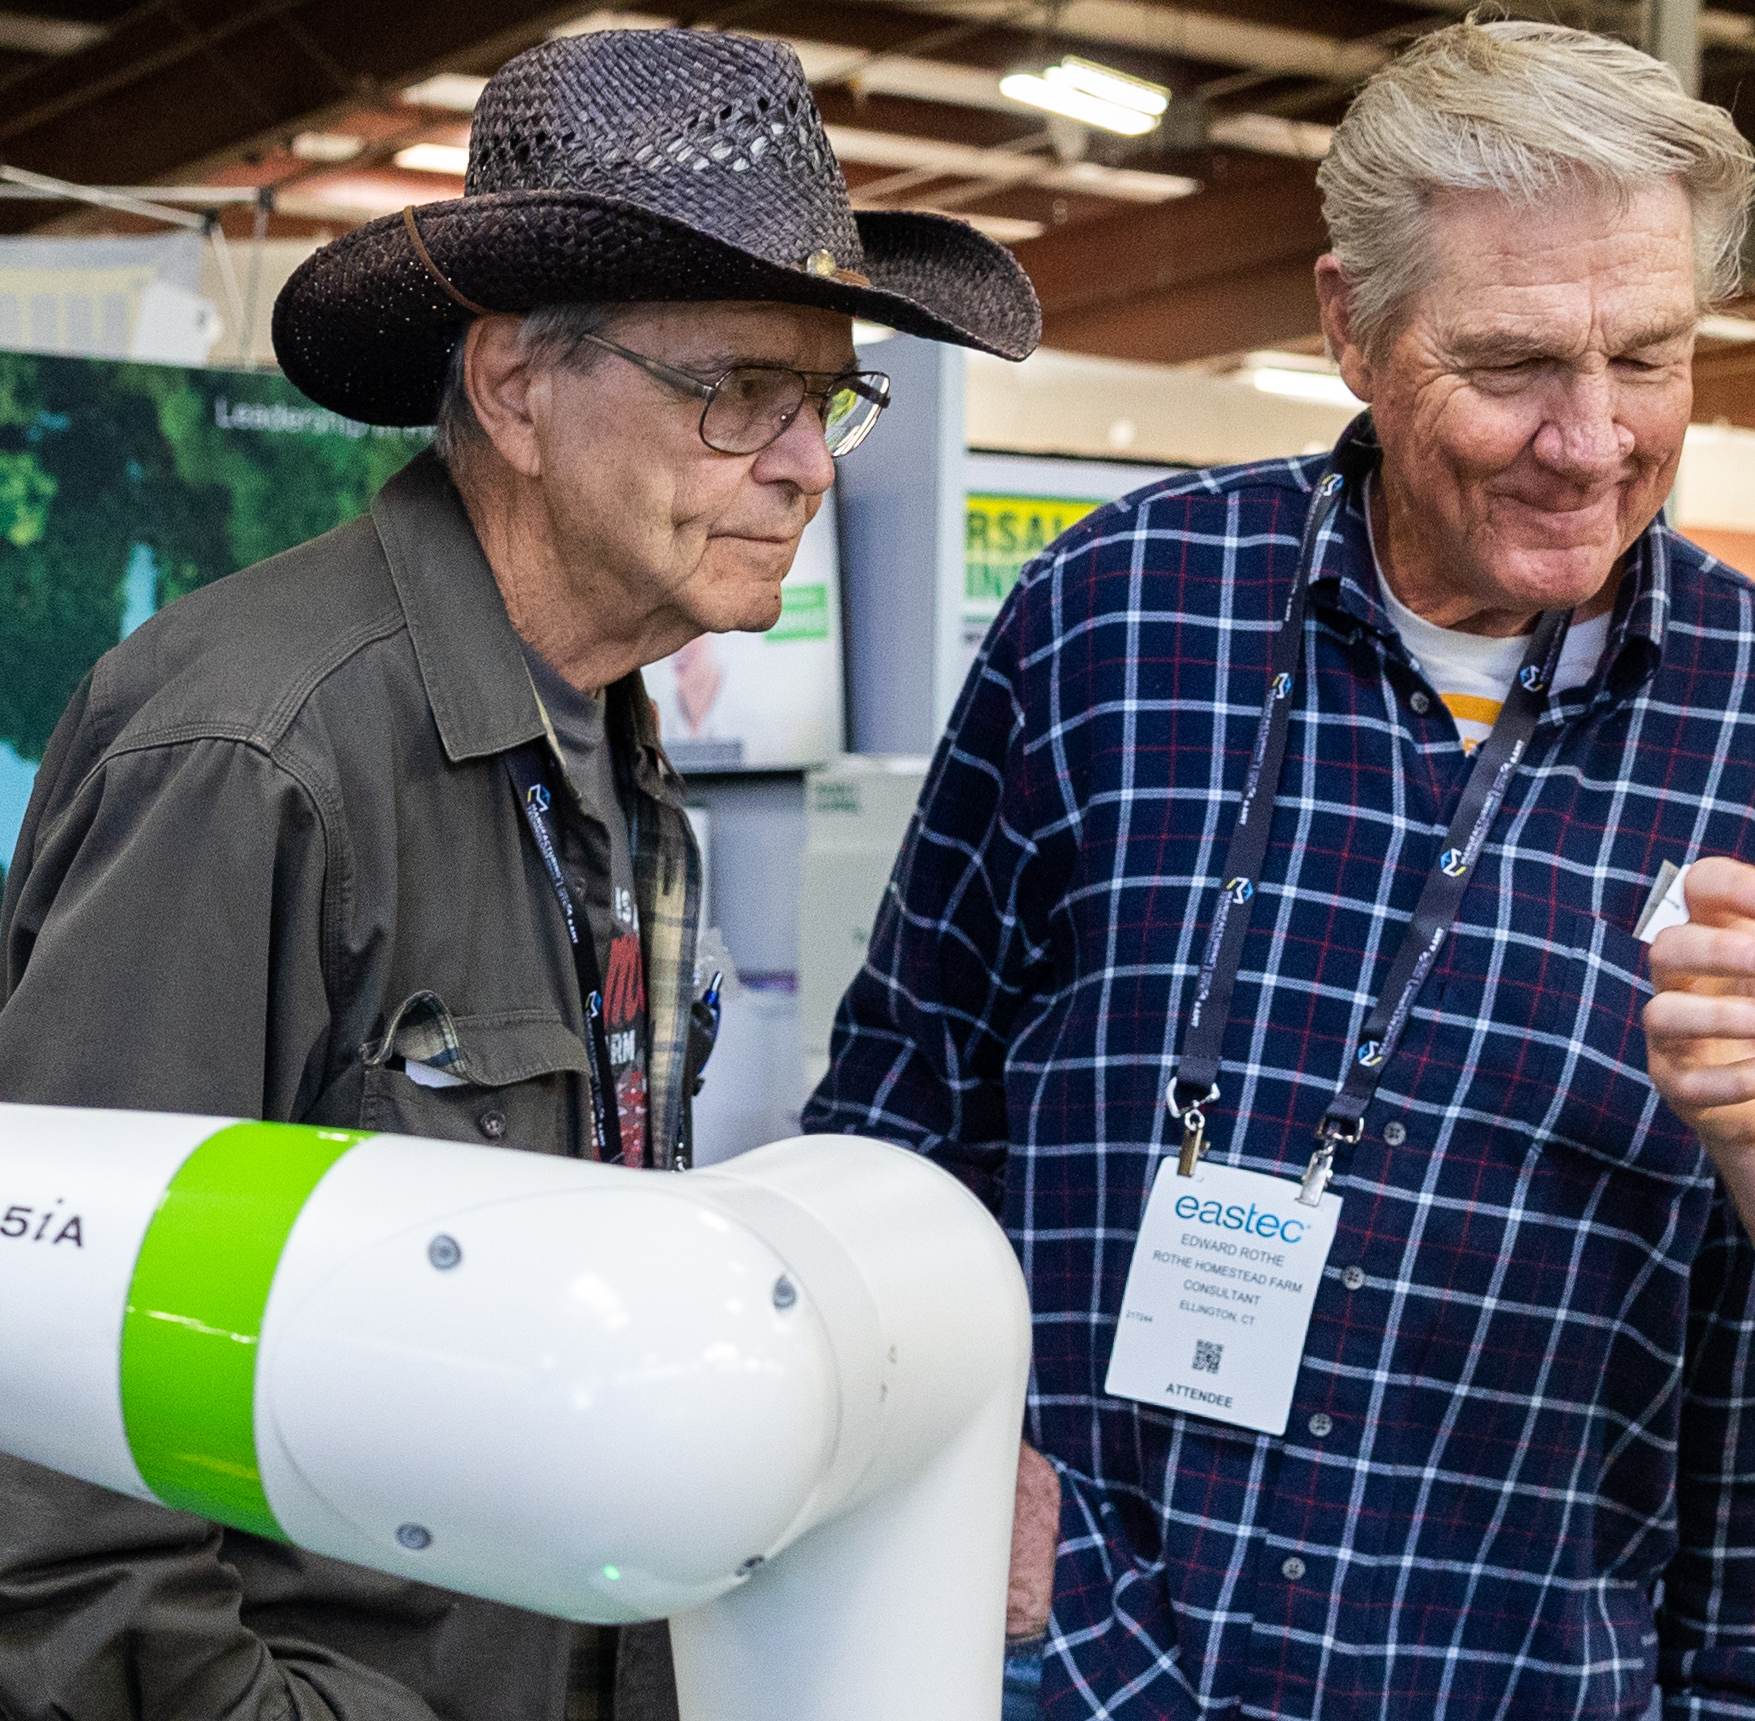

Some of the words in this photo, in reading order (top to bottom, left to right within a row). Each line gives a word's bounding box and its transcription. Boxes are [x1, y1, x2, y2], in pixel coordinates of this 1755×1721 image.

[1174, 1195, 1305, 1243] eastec
[1180, 1233, 1238, 1257] EDWARD
[1240, 1247, 1285, 1267] ROTHE
[1152, 1250, 1193, 1270] ROTHE
[1195, 1261, 1267, 1285] HOMESTEAD
[1269, 1277, 1304, 1293] FARM
[1183, 1279, 1261, 1306] CONSULTANT
[1165, 1383, 1233, 1408] ATTENDEE
